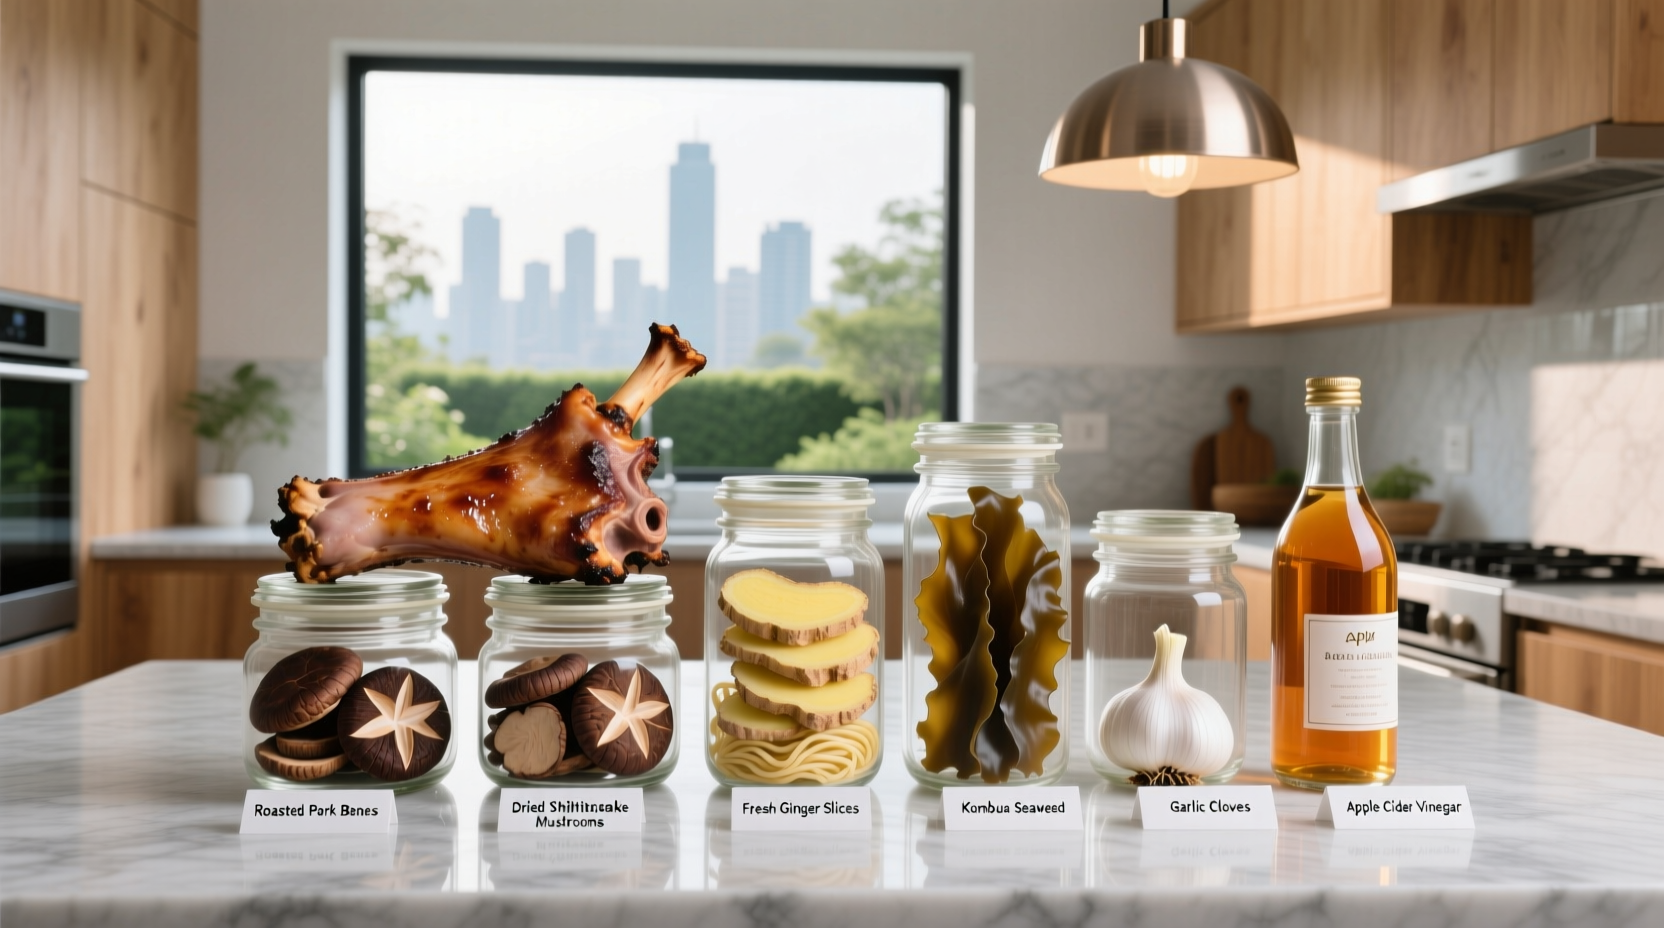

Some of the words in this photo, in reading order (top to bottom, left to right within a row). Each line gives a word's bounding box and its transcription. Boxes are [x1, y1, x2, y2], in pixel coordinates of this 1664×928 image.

[254, 804, 304, 817] Roasted
[512, 800, 545, 813] Dried
[742, 801, 776, 814] Fresh
[780, 801, 820, 817] Ginger
[823, 800, 859, 814] Slices
[1170, 800, 1205, 812] Garlic
[1209, 799, 1251, 812] Cloves
[1347, 800, 1380, 816] Apple
[1383, 800, 1413, 812] Cider
[1415, 800, 1462, 816] Vinegar
